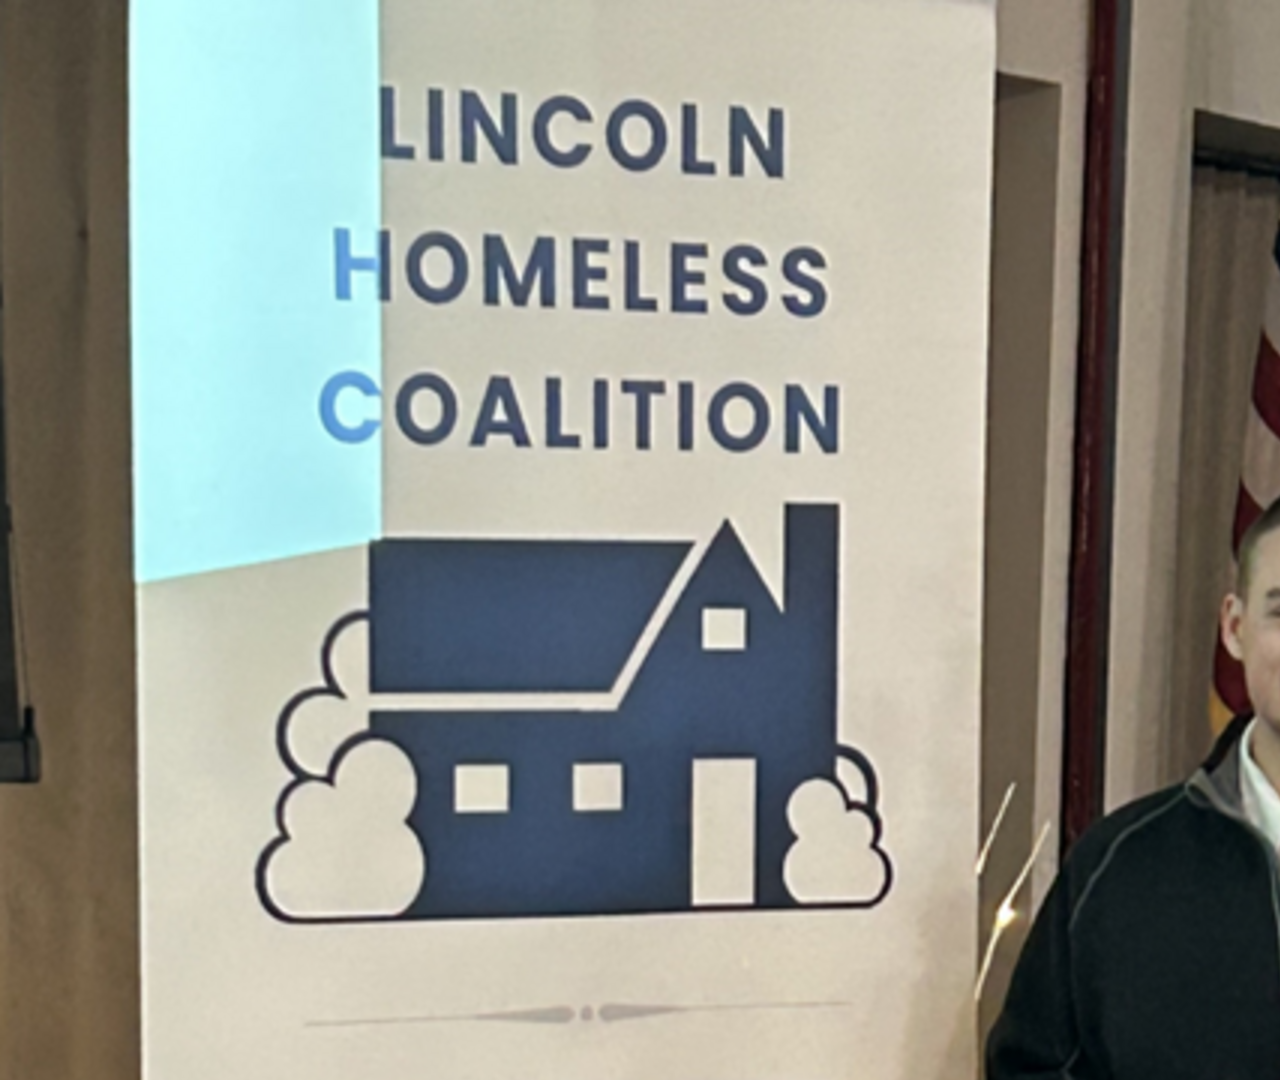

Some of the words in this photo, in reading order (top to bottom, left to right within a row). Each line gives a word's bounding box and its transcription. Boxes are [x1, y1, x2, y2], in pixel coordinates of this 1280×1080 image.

[379, 86, 786, 179] LINCOLN
[332, 226, 829, 318] HOMELESS
[318, 369, 841, 455] COALITION
